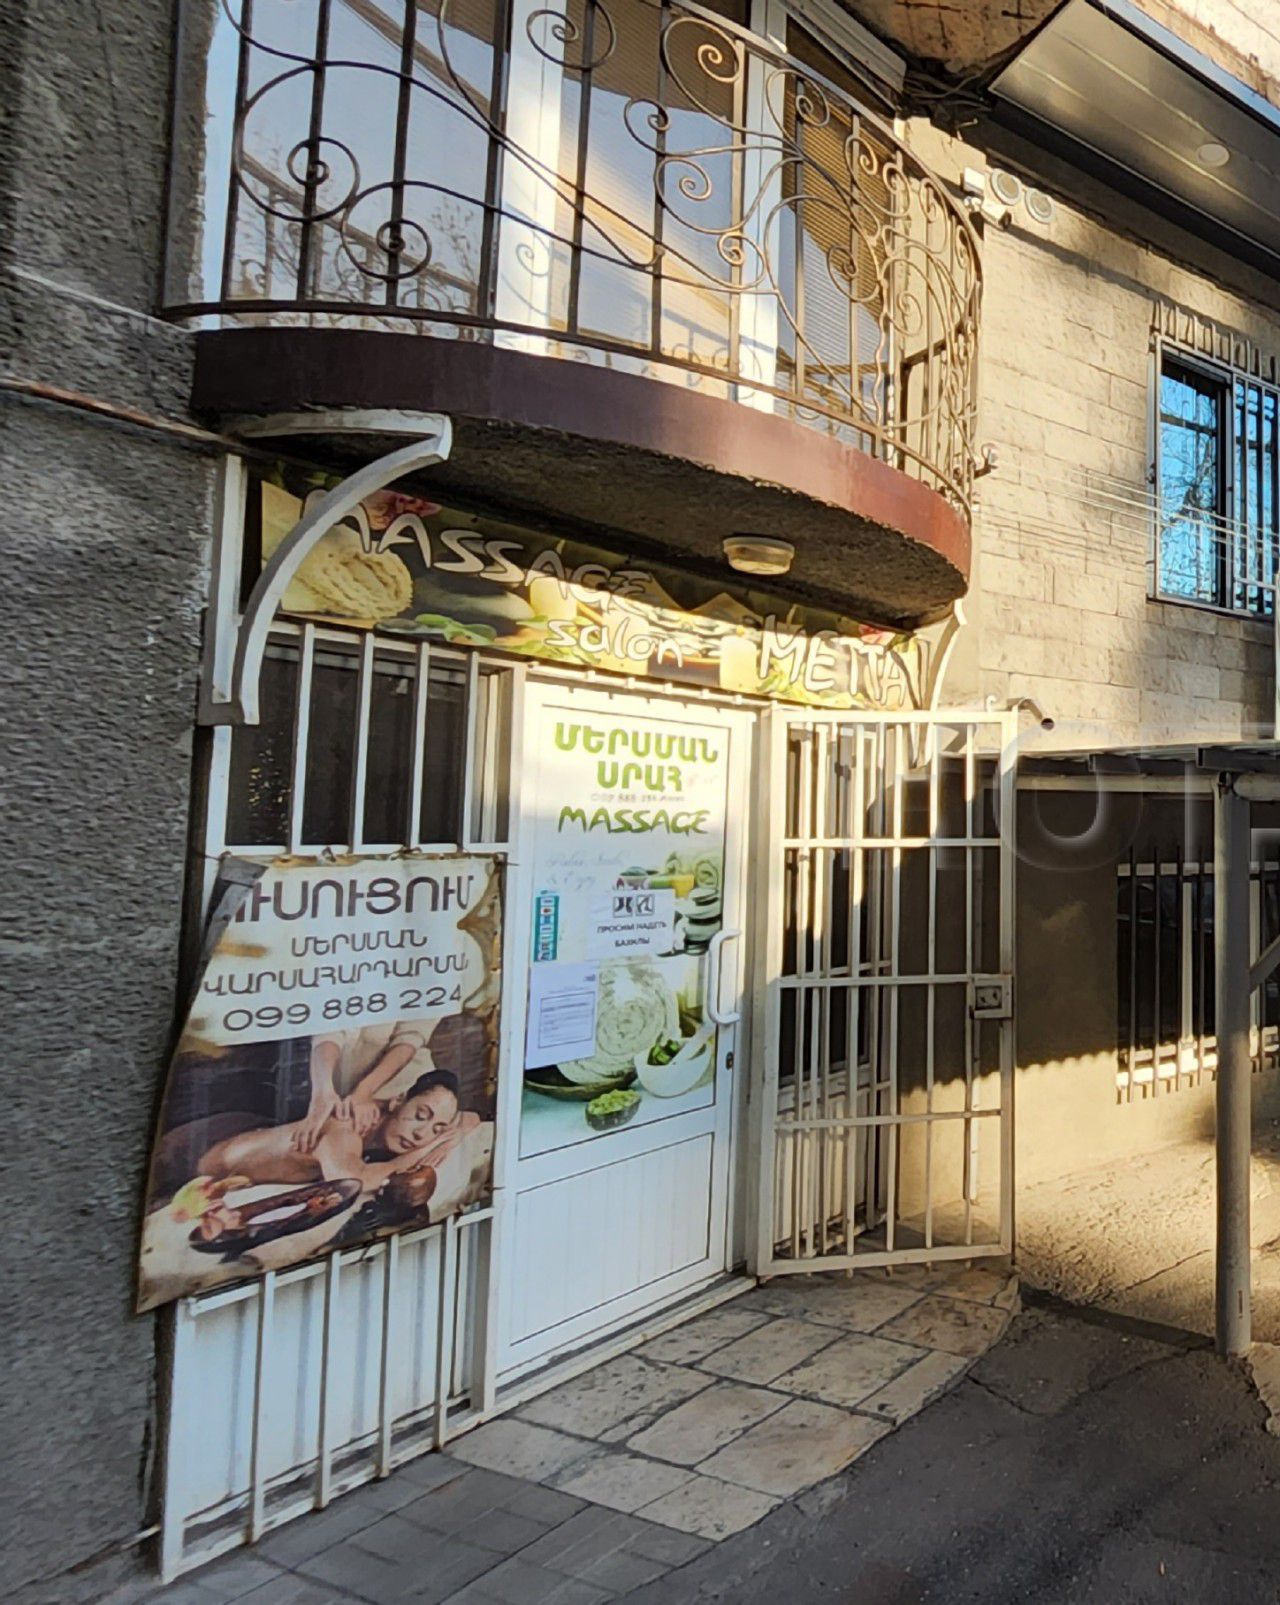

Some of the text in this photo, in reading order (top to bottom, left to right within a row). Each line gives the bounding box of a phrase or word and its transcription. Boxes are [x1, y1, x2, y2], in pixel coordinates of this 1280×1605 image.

[544, 613, 907, 707] salon METTA
[554, 722, 718, 764] ՄԵՐՍՄԱՆ
[597, 760, 683, 793] ՍՐԱՀ
[557, 805, 711, 837] MASSAGE
[235, 875, 474, 923] ՒՍՈՒՑՈՒՄ
[291, 929, 428, 958] ՄԵՐՍՄԱՆ
[222, 984, 462, 1032] 099 888 224
